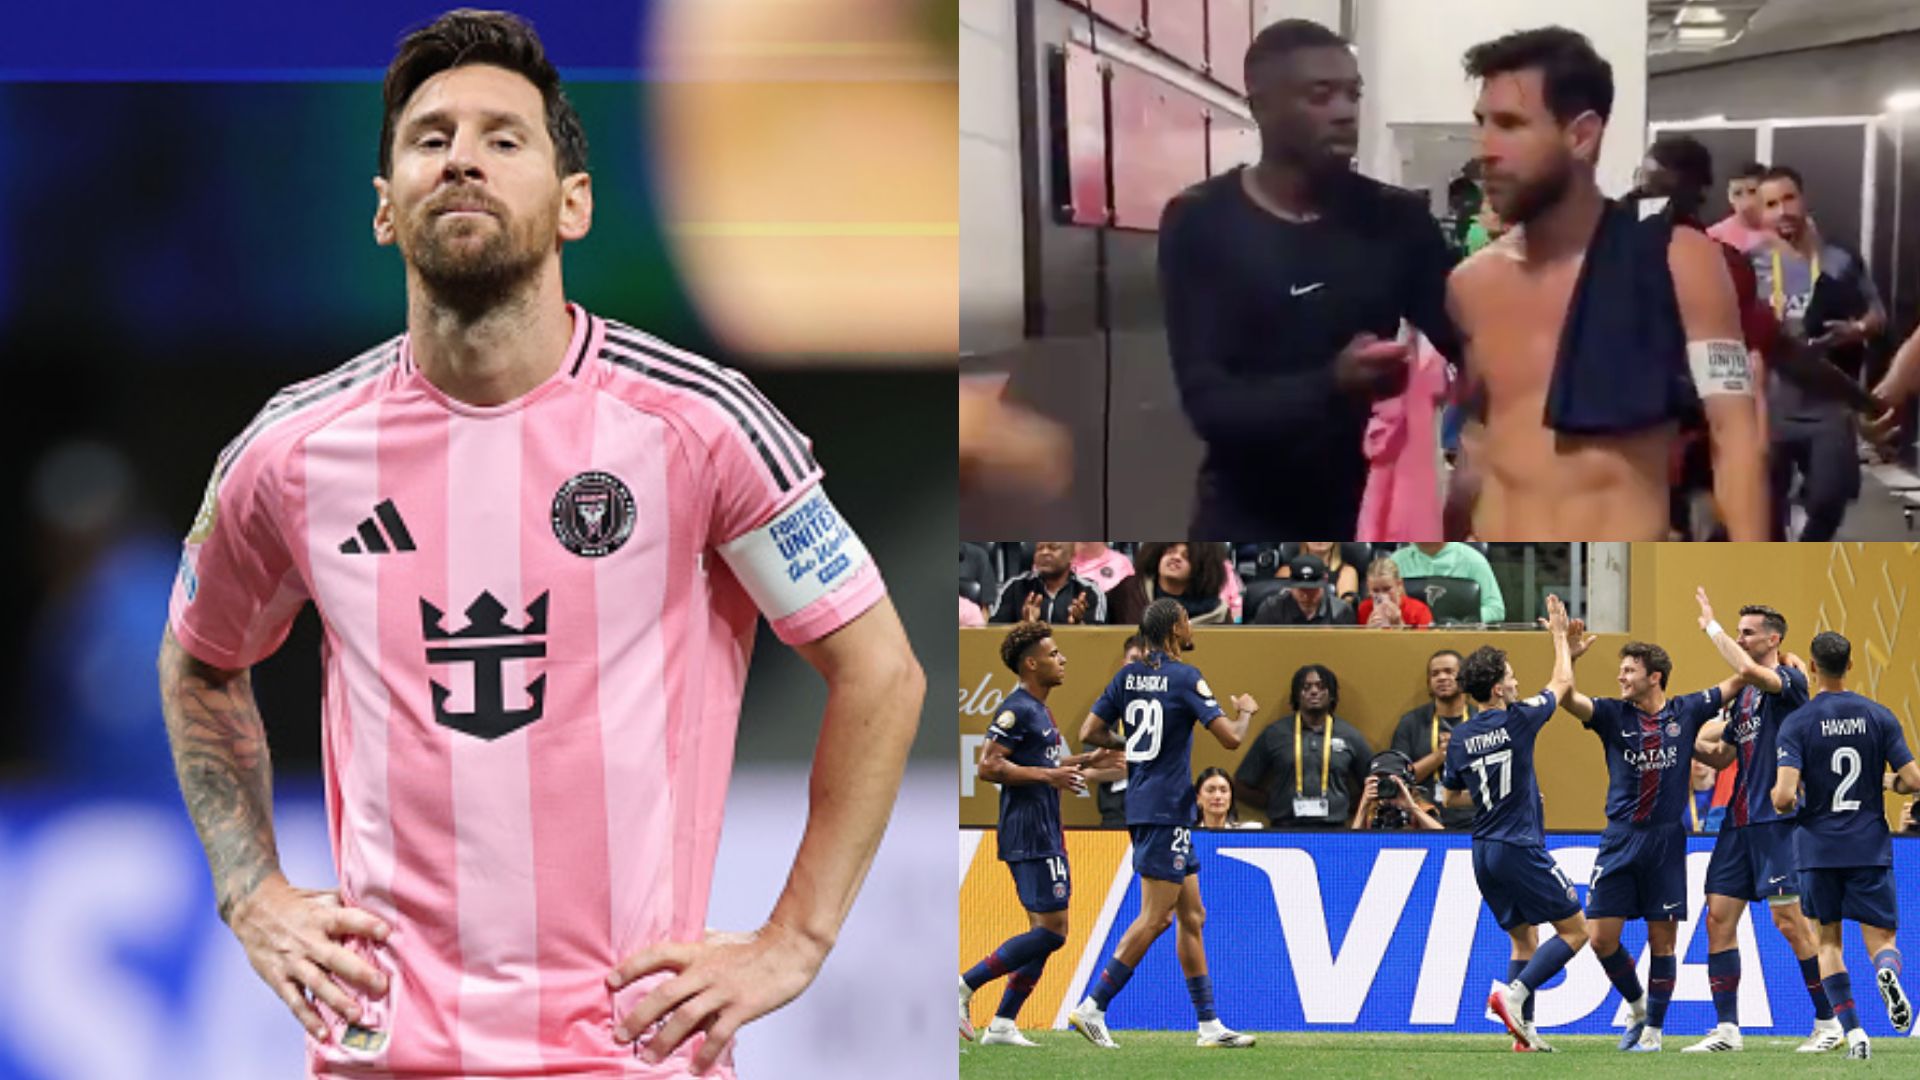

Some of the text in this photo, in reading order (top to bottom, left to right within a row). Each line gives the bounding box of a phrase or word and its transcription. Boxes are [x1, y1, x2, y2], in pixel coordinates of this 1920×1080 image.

[1125, 699, 1163, 761] 29
[1465, 727, 1512, 754] VITINHA
[1821, 717, 1866, 736] HAKIMI
[1624, 746, 1678, 765] QATAR
[1470, 749, 1512, 812] 17
[1831, 746, 1862, 812] 2
[1171, 826, 1191, 854] 29
[1046, 856, 1067, 881] 14
[1217, 847, 1773, 1026] VISA
